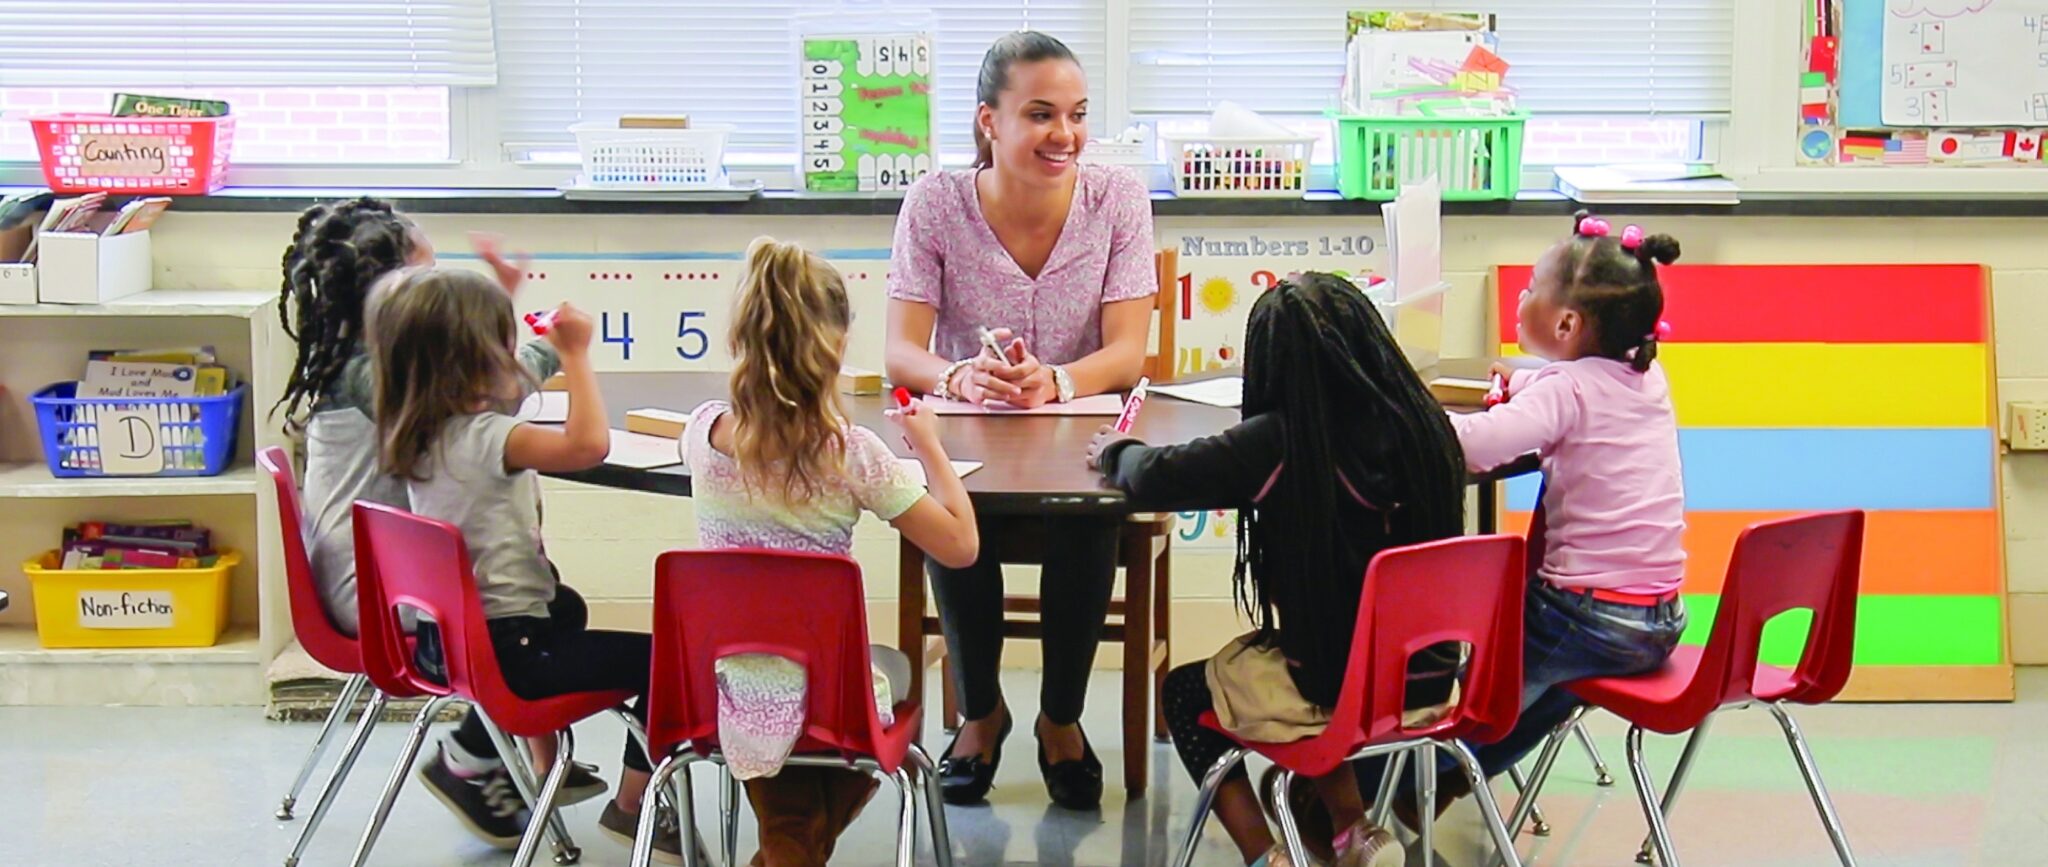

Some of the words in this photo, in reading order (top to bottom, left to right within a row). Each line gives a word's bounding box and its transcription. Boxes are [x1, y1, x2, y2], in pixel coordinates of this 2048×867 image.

[1909, 22, 1919, 34] 2
[2023, 15, 2038, 33] 4
[812, 64, 828, 74] 0
[1890, 64, 1902, 85] 5
[812, 83, 828, 93] 1
[134, 101, 165, 115] One
[812, 101, 828, 112] 2
[1906, 97, 1921, 117] 3
[813, 120, 829, 130] 3
[813, 139, 829, 149] 4
[84, 140, 165, 174] Counting
[814, 159, 829, 168] 5
[880, 169, 891, 186] 0
[899, 169, 909, 186] 1
[1181, 235, 1309, 257] Numbers
[1319, 235, 1374, 256] 1-10
[1177, 272, 1192, 320] 1
[602, 312, 634, 360] 4
[676, 312, 709, 360] 5
[110, 366, 117, 376] I
[121, 367, 147, 377] Love
[130, 378, 151, 387] and
[125, 388, 155, 397] Loves
[118, 416, 155, 459] D
[80, 592, 174, 618] Non-fiction
